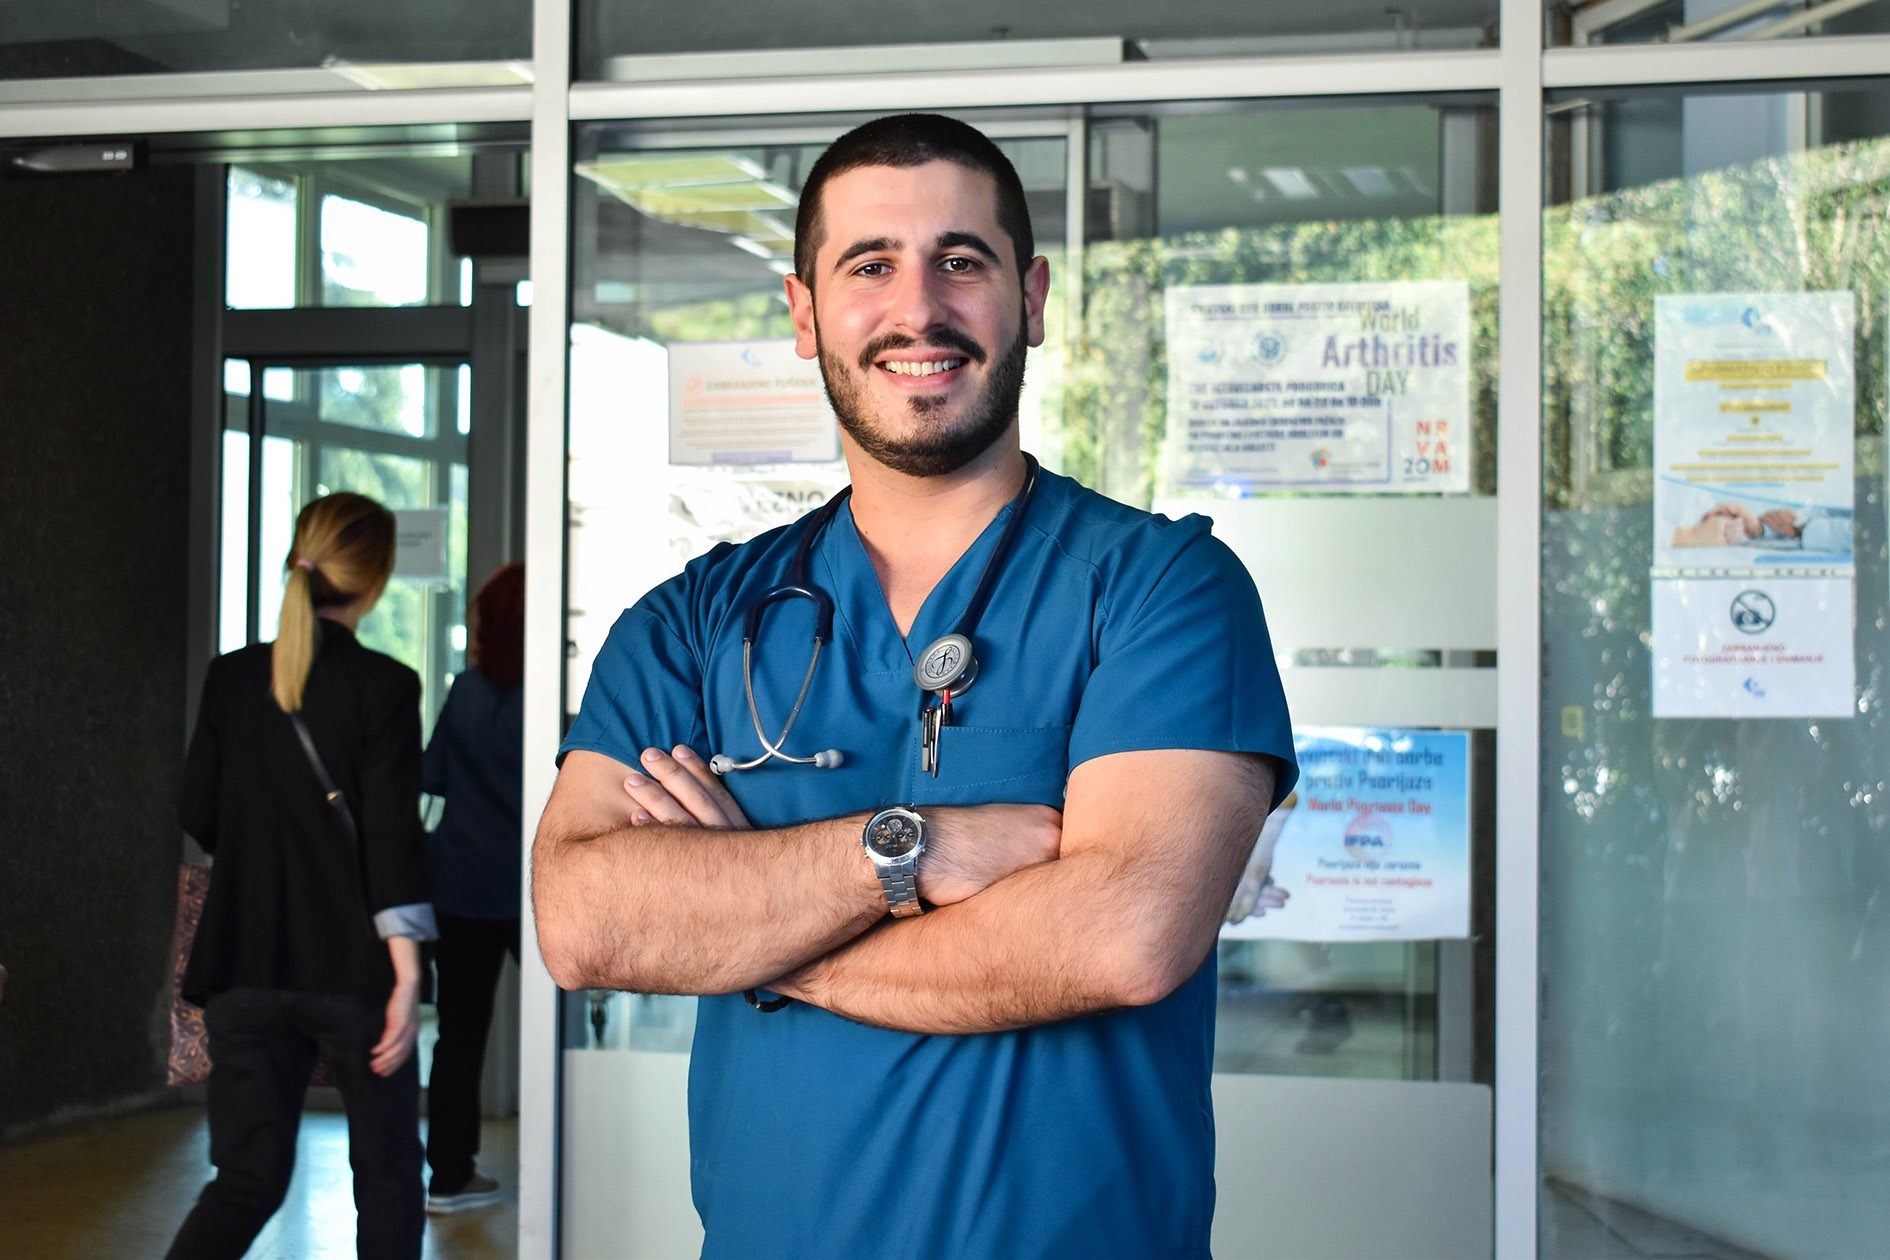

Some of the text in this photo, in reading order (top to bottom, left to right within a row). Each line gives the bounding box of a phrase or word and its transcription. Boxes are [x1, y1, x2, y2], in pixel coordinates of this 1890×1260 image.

[1359, 307, 1421, 333] World
[1322, 334, 1458, 368] Arthritis
[1366, 370, 1410, 396] DAY
[1308, 799, 1343, 812] World
[1408, 799, 1431, 815] Day
